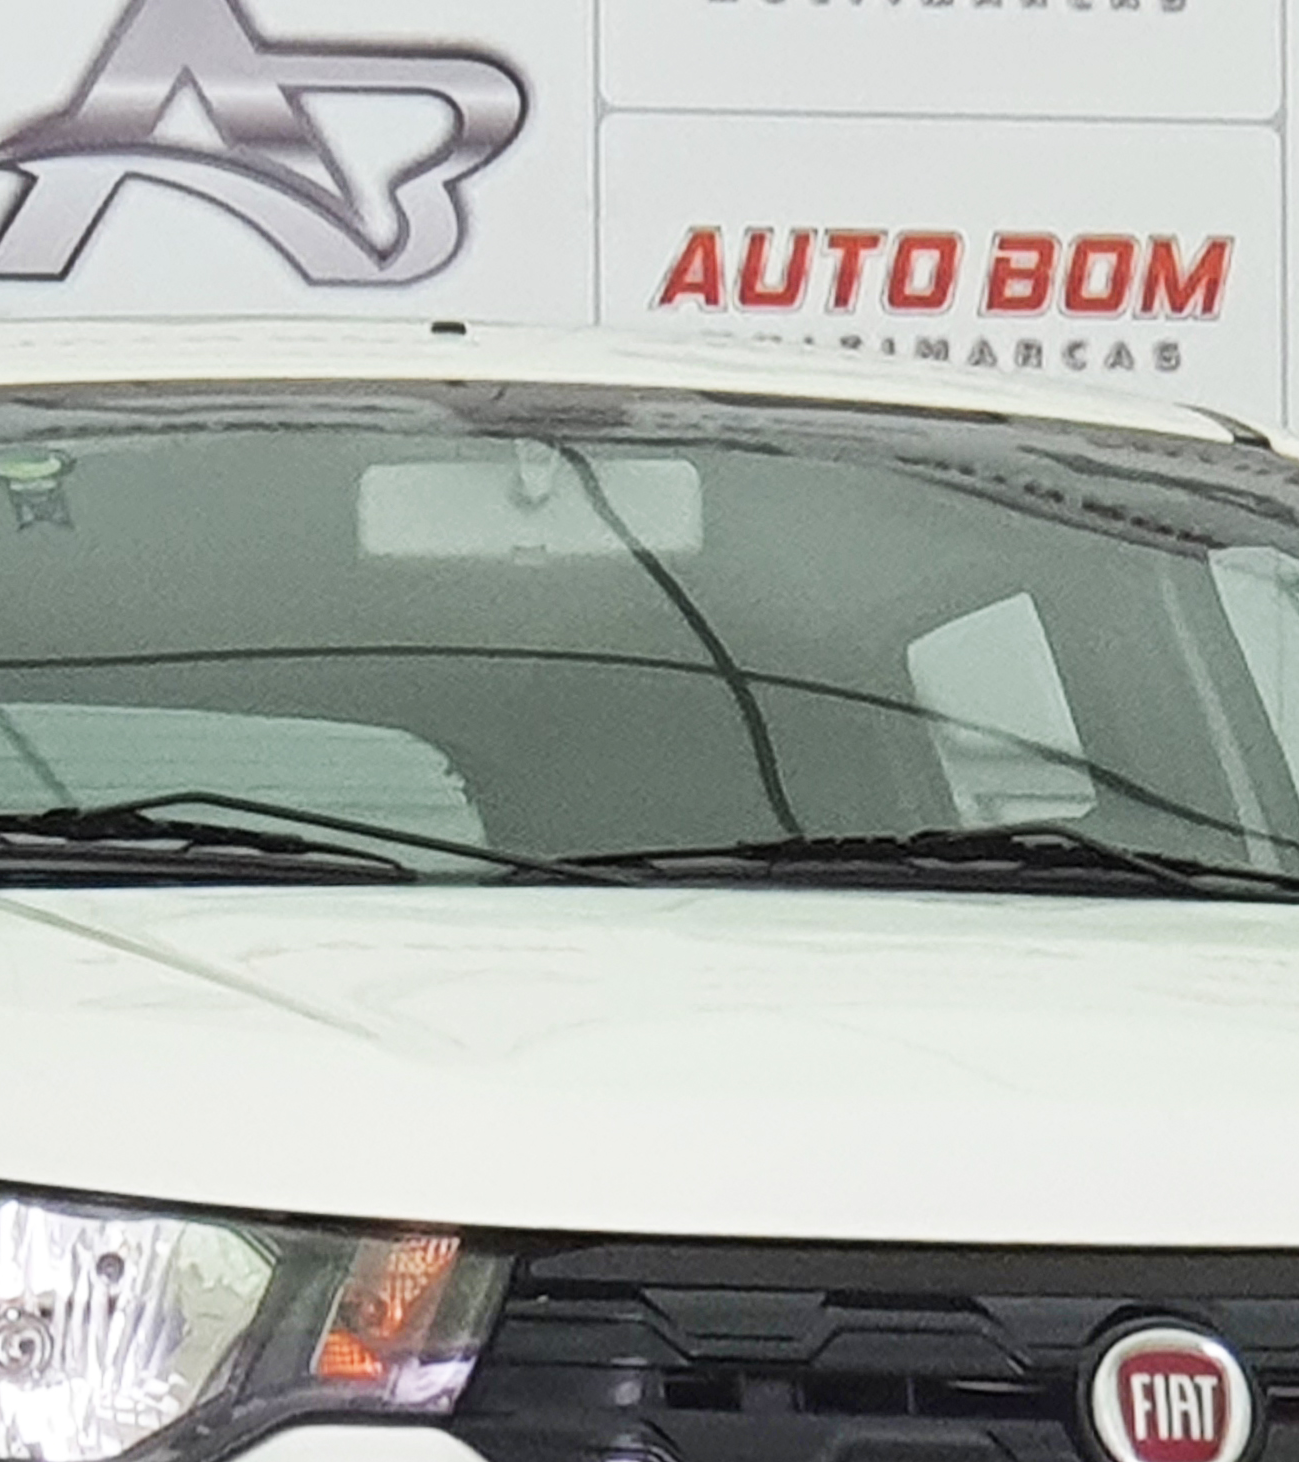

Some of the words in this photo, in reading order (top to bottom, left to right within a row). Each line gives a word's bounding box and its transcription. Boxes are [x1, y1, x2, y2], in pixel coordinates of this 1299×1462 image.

[654, 225, 964, 317] AUTO
[978, 231, 1236, 322] BOM
[1129, 1373, 1219, 1442] FIAT
